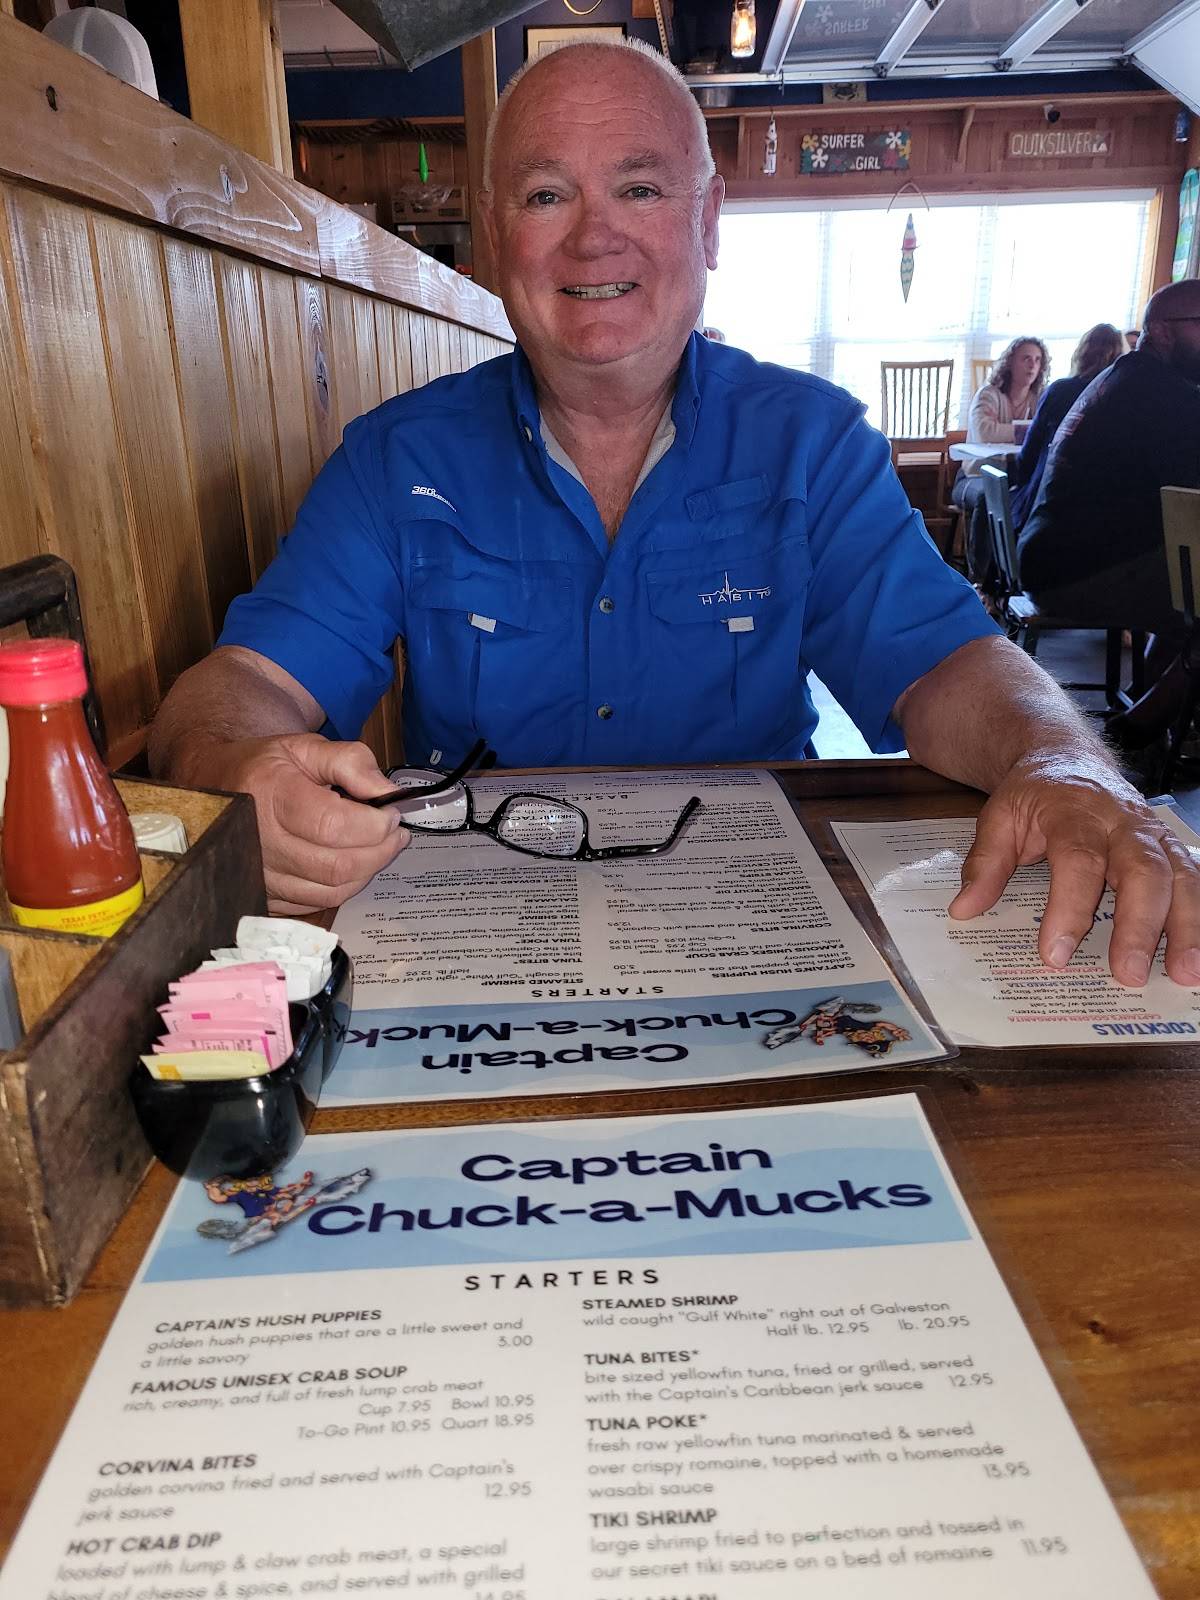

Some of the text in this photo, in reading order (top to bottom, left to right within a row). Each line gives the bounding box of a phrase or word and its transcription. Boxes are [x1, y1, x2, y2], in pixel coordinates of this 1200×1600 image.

[821, 134, 865, 149] SURFER
[1011, 132, 1092, 155] QUIKSILVER
[855, 156, 881, 170] GIRL
[701, 592, 766, 605] HABIT
[794, 944, 844, 952] FAMOUS
[529, 986, 664, 999] STARTERS
[344, 1008, 797, 1048] Chuck-a-Muck
[1093, 1022, 1197, 1036] COCKTAILS
[420, 1043, 689, 1076] Captain
[460, 1142, 773, 1185] Captain
[307, 1178, 933, 1237] Chuck-a-Mucks
[464, 1269, 660, 1291] STARTERS
[583, 1295, 738, 1310] STEAMED SHRIMP
[155, 1310, 381, 1333] CAPTAIN'S HUSH PUPPIES
[583, 1314, 614, 1326] wild
[619, 1312, 674, 1327] caught
[780, 1307, 814, 1322] right
[820, 1307, 844, 1317] out
[850, 1304, 865, 1316] of
[870, 1302, 950, 1315] Galveston
[766, 1315, 970, 1336] Half lb. 12.95 lb. 20.95
[147, 1318, 523, 1354] golden hush puppies that are a little sweet and
[140, 1354, 250, 1368] a little savory
[584, 1353, 635, 1365] TUNA
[585, 1371, 617, 1383] bite
[622, 1369, 665, 1383] sized
[669, 1366, 743, 1384] yellowfin
[794, 1362, 832, 1376] fried
[837, 1365, 854, 1374] or
[920, 1355, 974, 1370] served
[131, 1366, 407, 1394] FAMOUS UNISEX CRAB SOUP
[948, 1372, 994, 1387] 12.95
[229, 1392, 261, 1406] and
[266, 1390, 290, 1402] full
[294, 1389, 312, 1401] of
[316, 1387, 354, 1399] fresh
[359, 1386, 397, 1399] lump
[402, 1382, 438, 1394] crab
[443, 1379, 484, 1391] meat
[585, 1389, 620, 1403] with
[626, 1389, 653, 1401] the
[743, 1383, 834, 1398] Caribbean
[839, 1380, 869, 1397] jerk
[873, 1381, 924, 1392] sauce
[358, 1394, 535, 1417] Cup 7.95 Bowl 10.95
[298, 1413, 534, 1439] To-Go Pint 10.95 Quart 18.95
[586, 1417, 640, 1431] TUNA
[587, 1421, 975, 1453] fresh raw yellowfin tuna marinated & served
[99, 1454, 257, 1476] CORVINA BITES
[588, 1464, 626, 1475] over
[631, 1460, 683, 1476] crispy
[772, 1450, 838, 1471] topped
[843, 1448, 881, 1464] with
[886, 1452, 899, 1462] a
[902, 1441, 1005, 1461] homemade
[87, 1482, 153, 1504] golden
[158, 1481, 225, 1496] corvina
[232, 1473, 275, 1490] fried
[279, 1471, 315, 1488] and
[320, 1467, 380, 1486] served
[385, 1465, 423, 1480] with
[485, 1481, 532, 1499] 12.95
[588, 1481, 714, 1498] wasabi sauce
[76, 1507, 175, 1527] jerk sauce
[590, 1508, 717, 1528] TIKI SHRIMP
[66, 1532, 222, 1555] HOT CRAB DIP
